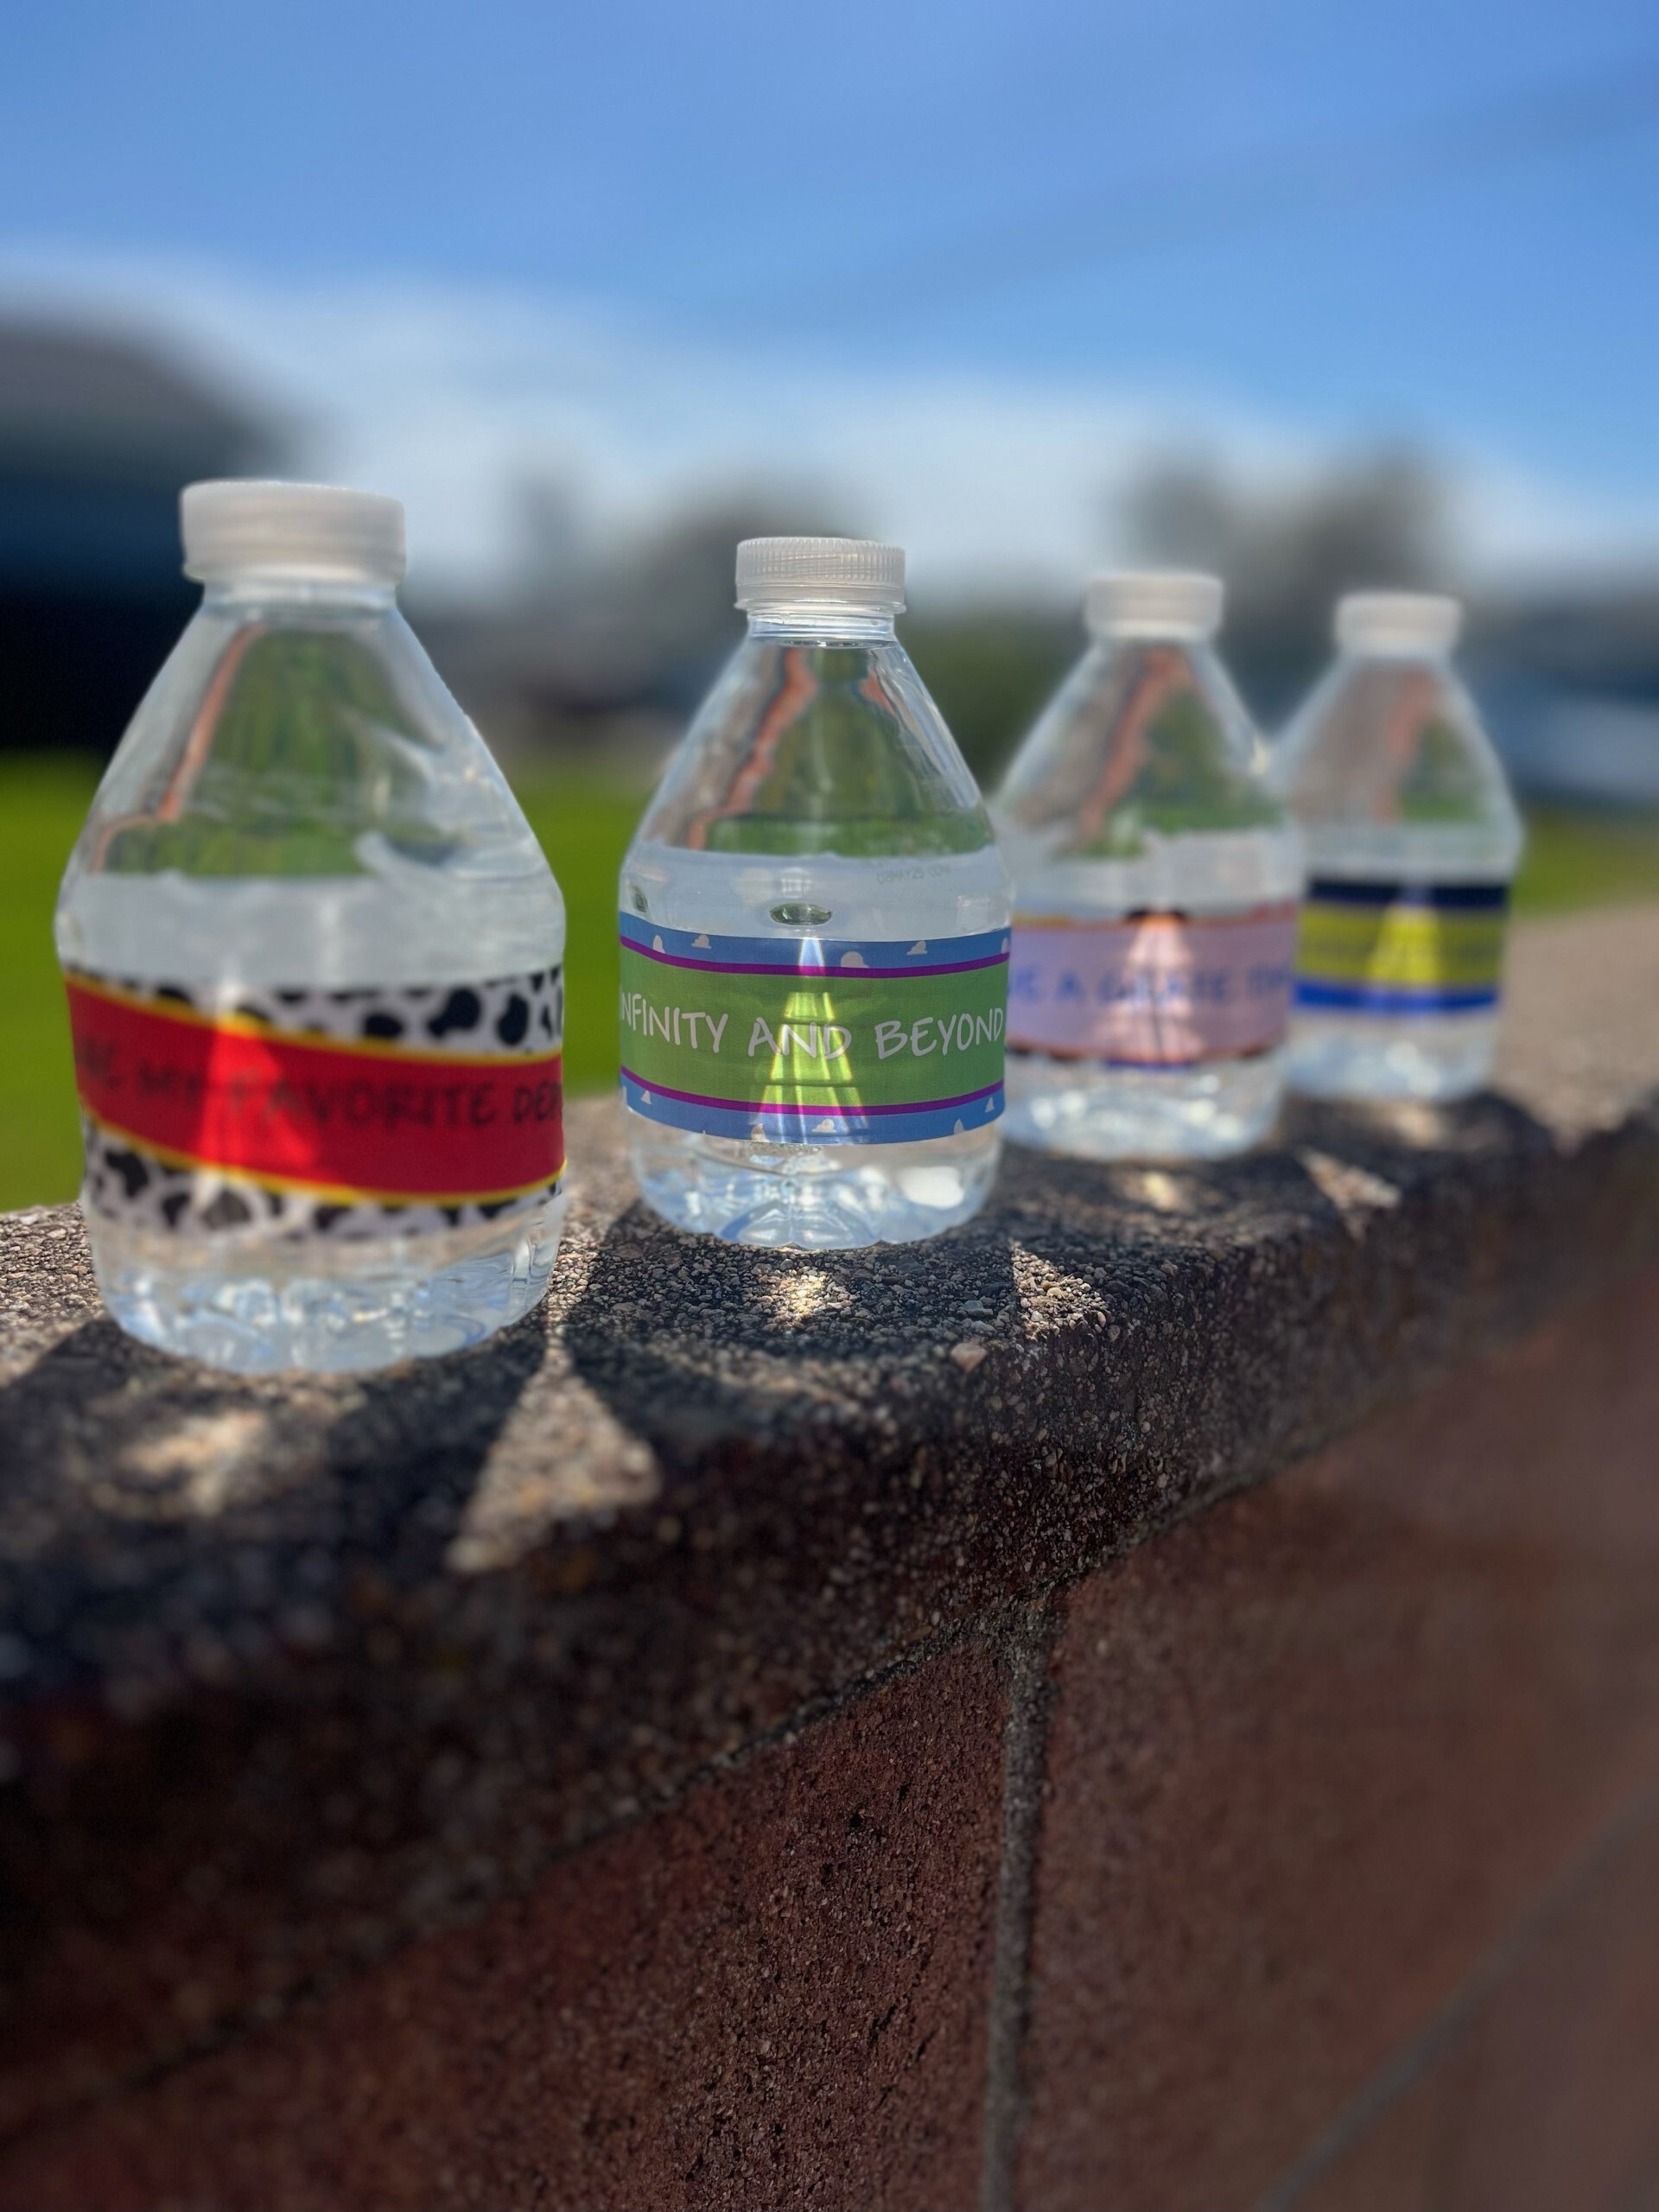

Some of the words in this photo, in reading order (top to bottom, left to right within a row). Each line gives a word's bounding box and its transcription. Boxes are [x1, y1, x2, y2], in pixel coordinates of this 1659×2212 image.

[620, 989, 729, 1054] NFINITY
[747, 1017, 853, 1060] AND
[874, 1007, 1003, 1060] BEYOND
